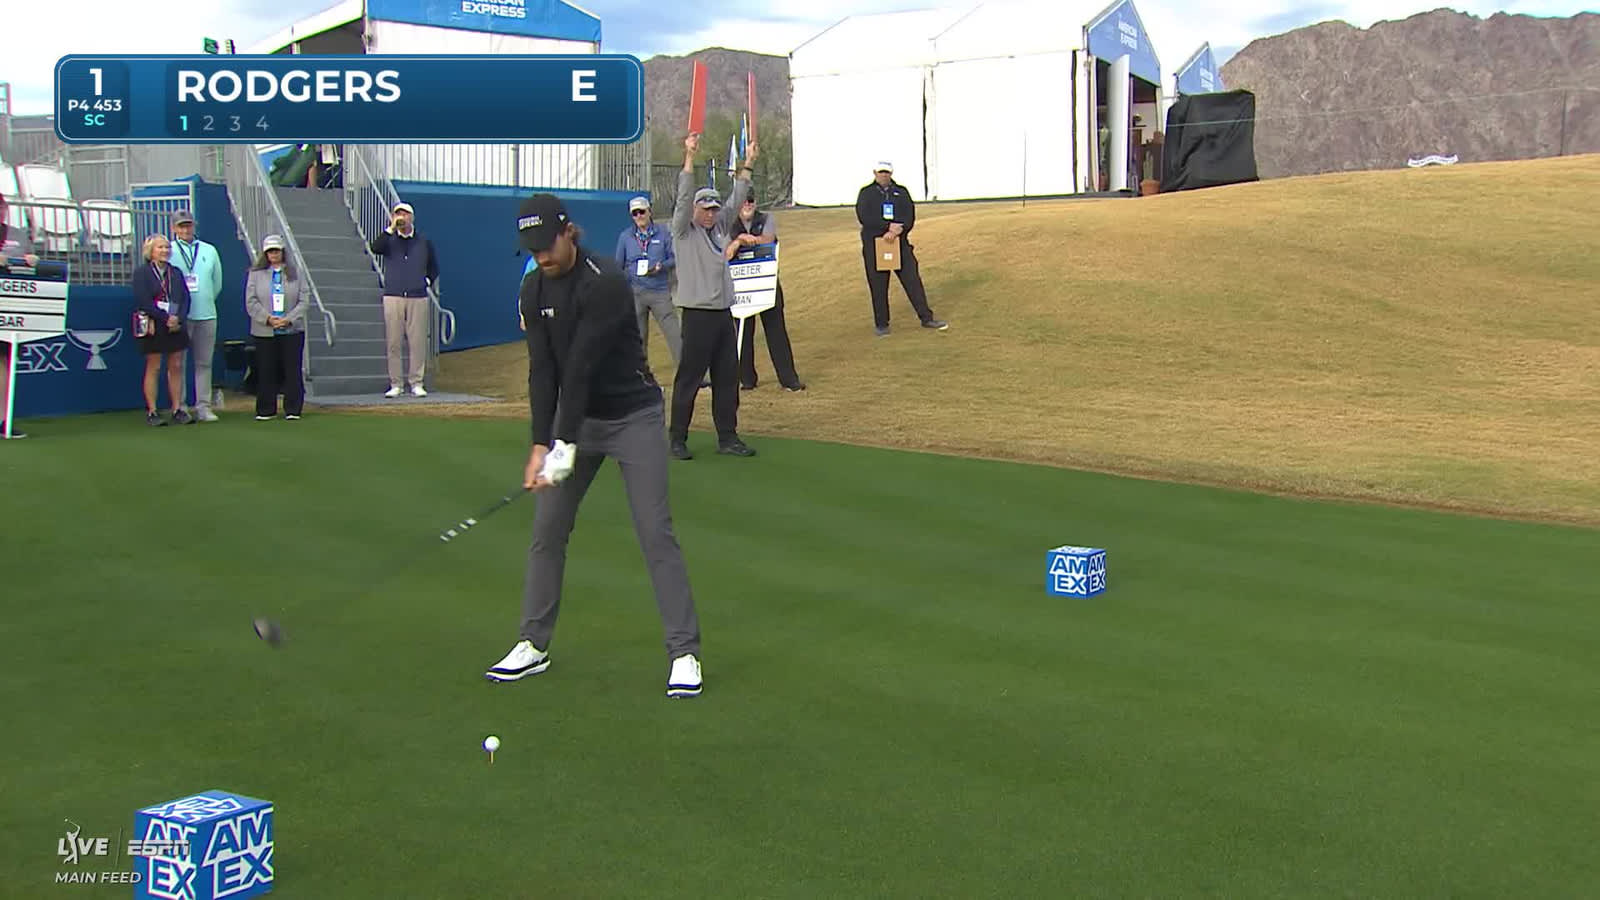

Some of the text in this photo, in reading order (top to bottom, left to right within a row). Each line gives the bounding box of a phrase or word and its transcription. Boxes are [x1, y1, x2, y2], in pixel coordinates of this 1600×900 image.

[462, 1, 526, 18] EXPRESS
[1049, 554, 1088, 576] AM
[1055, 573, 1087, 594] EX
[202, 807, 274, 867] AM
[147, 855, 197, 900] EX
[213, 841, 274, 899] EX
